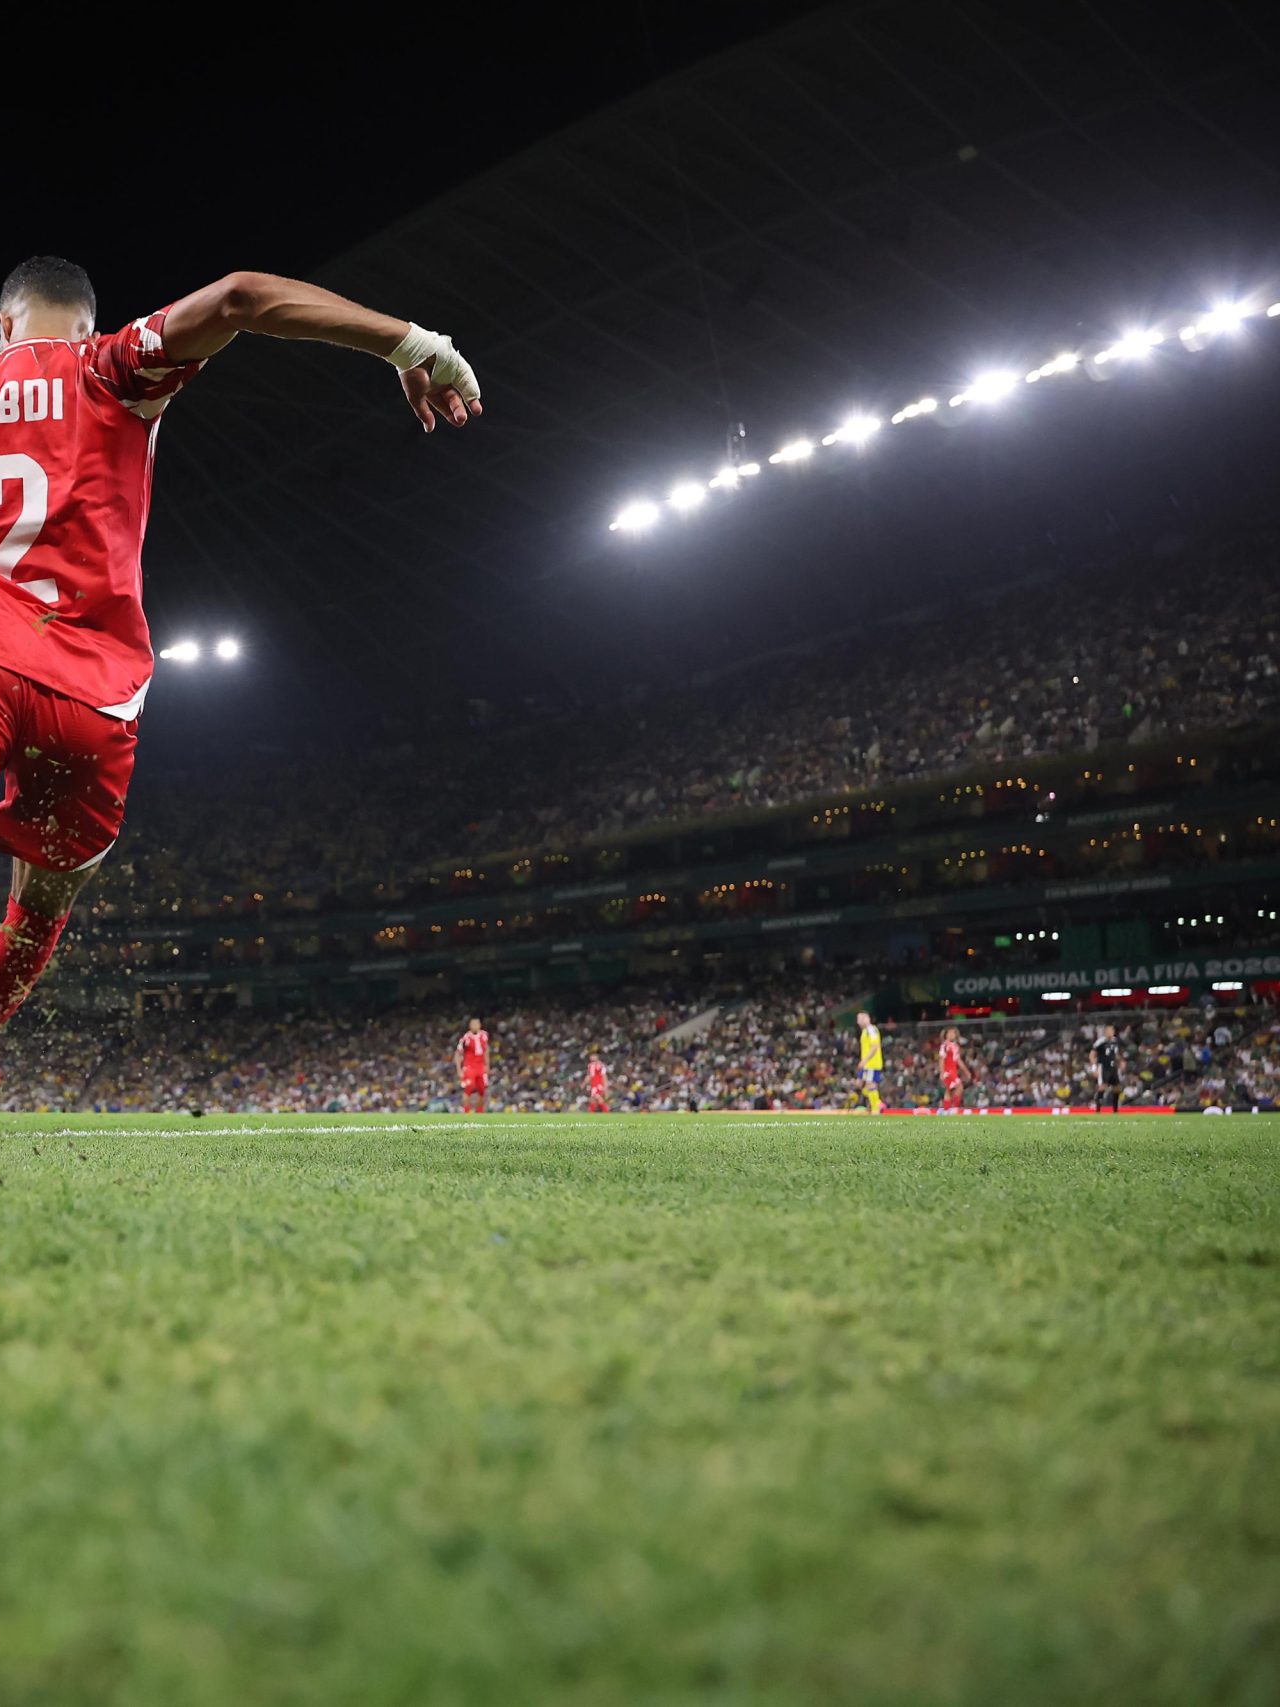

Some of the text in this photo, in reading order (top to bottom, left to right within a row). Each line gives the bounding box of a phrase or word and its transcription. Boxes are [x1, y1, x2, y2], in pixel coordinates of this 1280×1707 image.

[953, 956, 1280, 994] COPA MUNDIAL DE LA FIFA 2026
